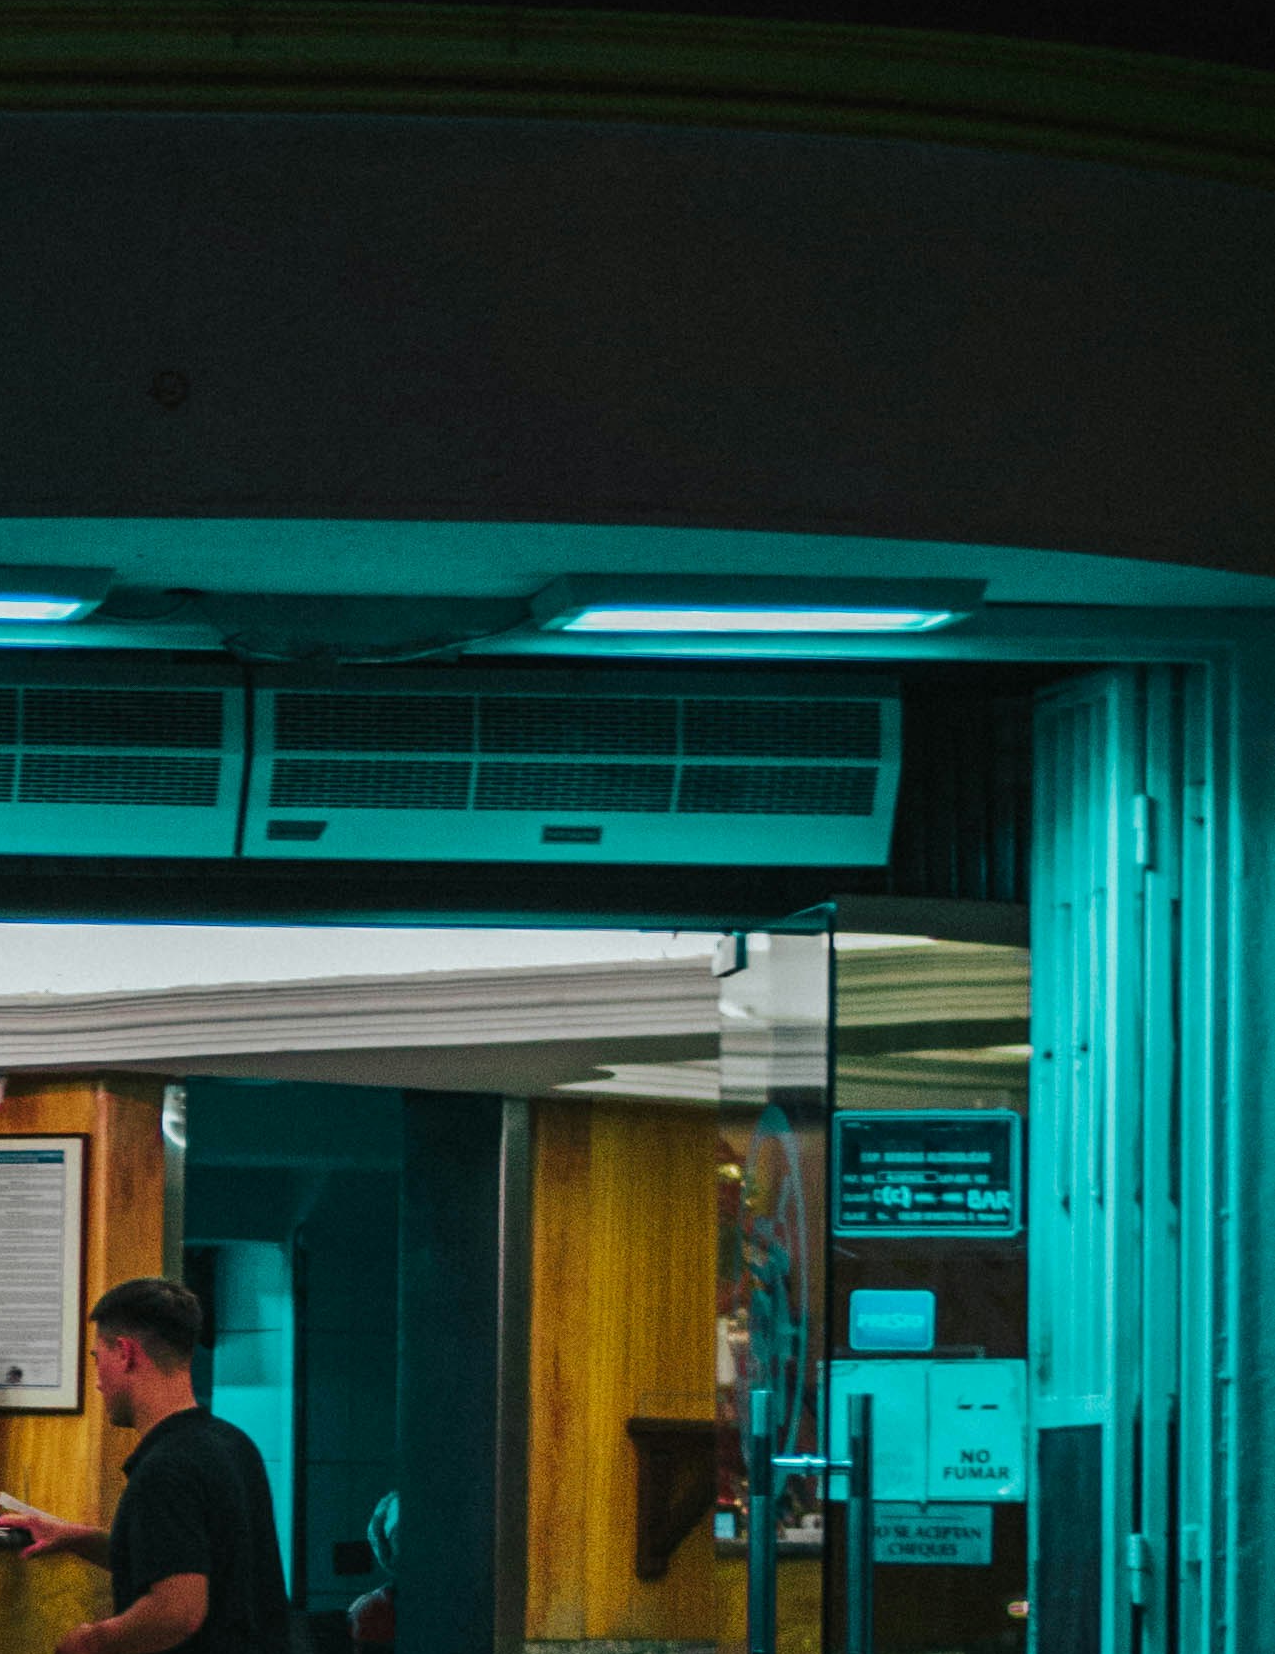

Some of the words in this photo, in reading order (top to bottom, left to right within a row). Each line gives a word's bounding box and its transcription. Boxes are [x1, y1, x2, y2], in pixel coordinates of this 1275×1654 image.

[967, 1189, 1011, 1210] BAR
[960, 1449, 990, 1464] NO
[943, 1466, 1009, 1480] FUMAR
